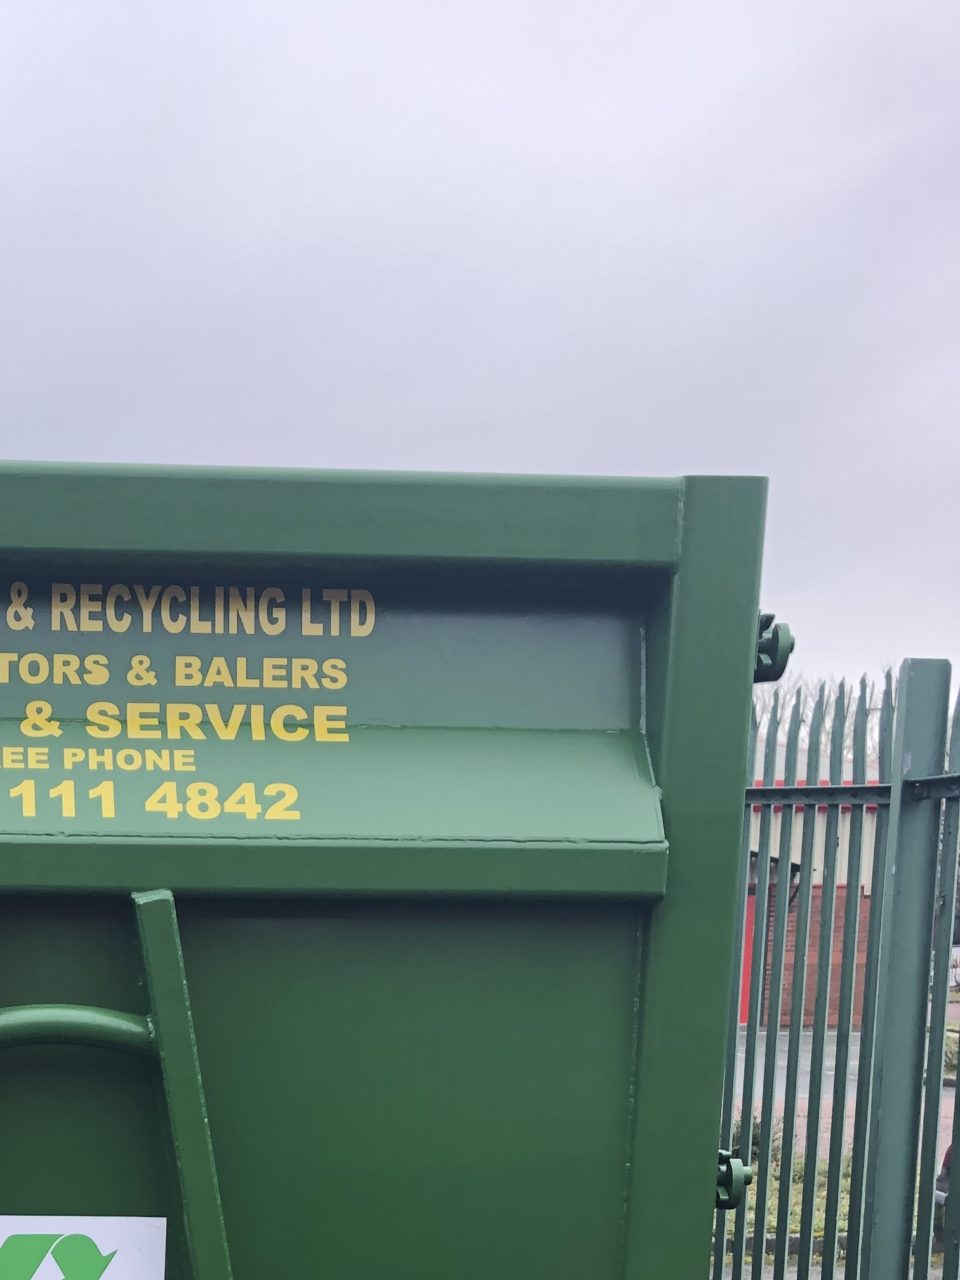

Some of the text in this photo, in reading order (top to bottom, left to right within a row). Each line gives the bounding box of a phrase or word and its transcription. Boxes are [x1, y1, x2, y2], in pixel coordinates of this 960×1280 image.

[6, 581, 34, 631] &
[51, 583, 286, 636] RECYCLING
[302, 588, 376, 637] LTD
[127, 655, 157, 687] &
[175, 656, 348, 690] BALERS
[20, 700, 62, 738] &
[85, 700, 350, 743] SERVICE
[63, 747, 196, 772] PHONE
[9, 779, 116, 819] 111
[144, 780, 301, 821] 4842
